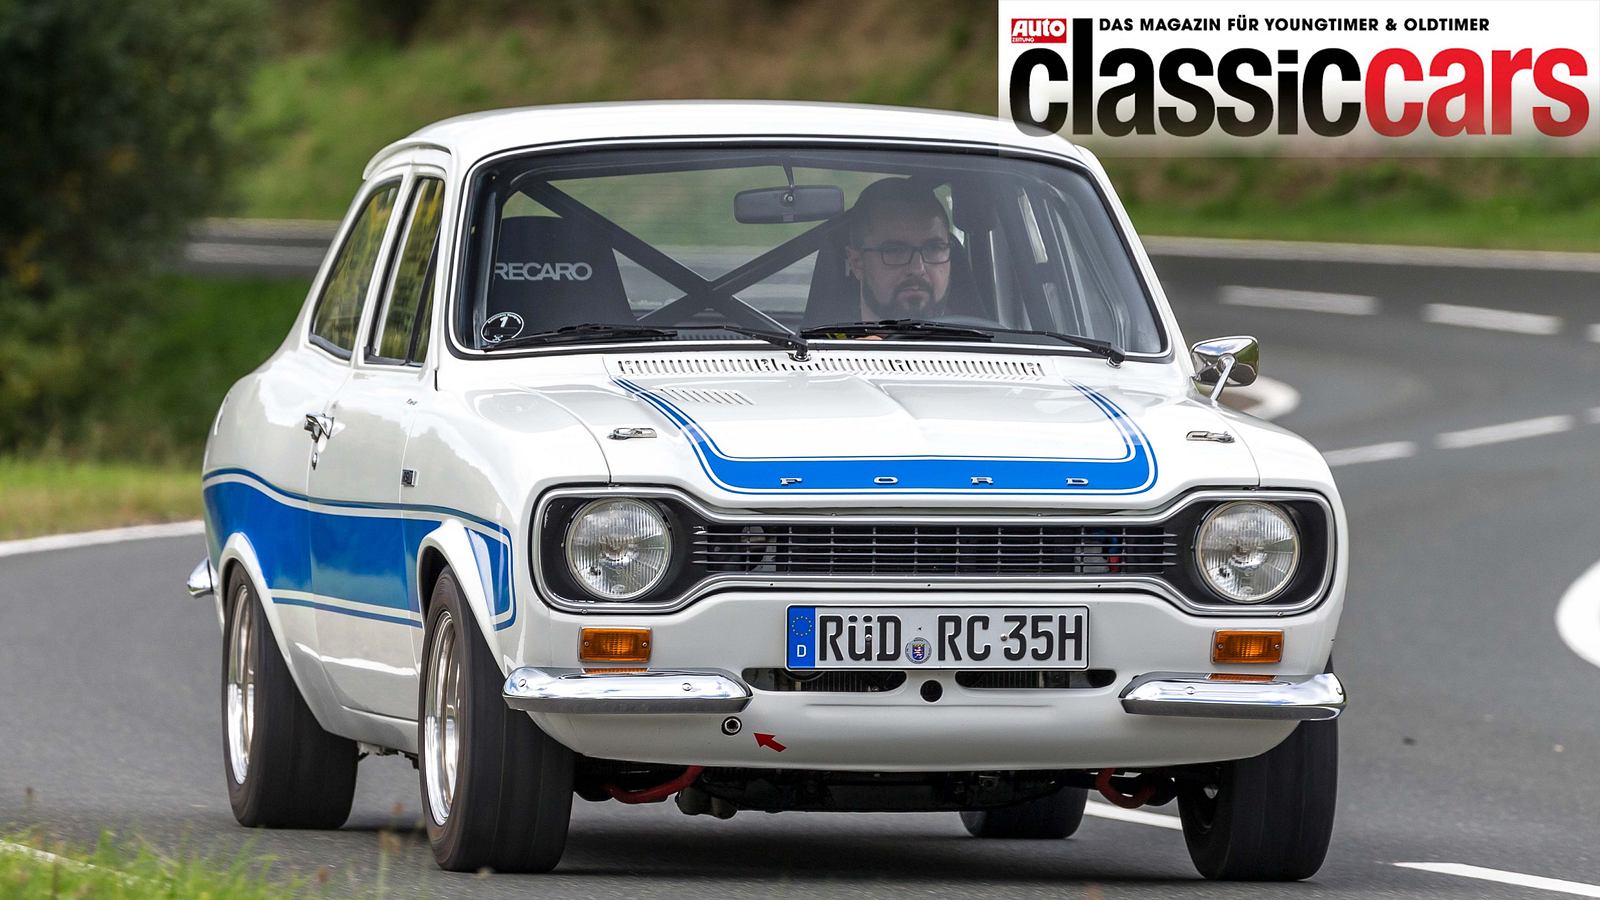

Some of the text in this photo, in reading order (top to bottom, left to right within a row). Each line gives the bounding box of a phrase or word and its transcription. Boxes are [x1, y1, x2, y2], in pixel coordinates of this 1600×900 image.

[495, 262, 593, 281] RECARO
[499, 316, 509, 328] 1
[780, 476, 1089, 485] FORD
[938, 615, 991, 661] RC
[1003, 615, 1083, 661] 35H
[796, 644, 807, 658] D
